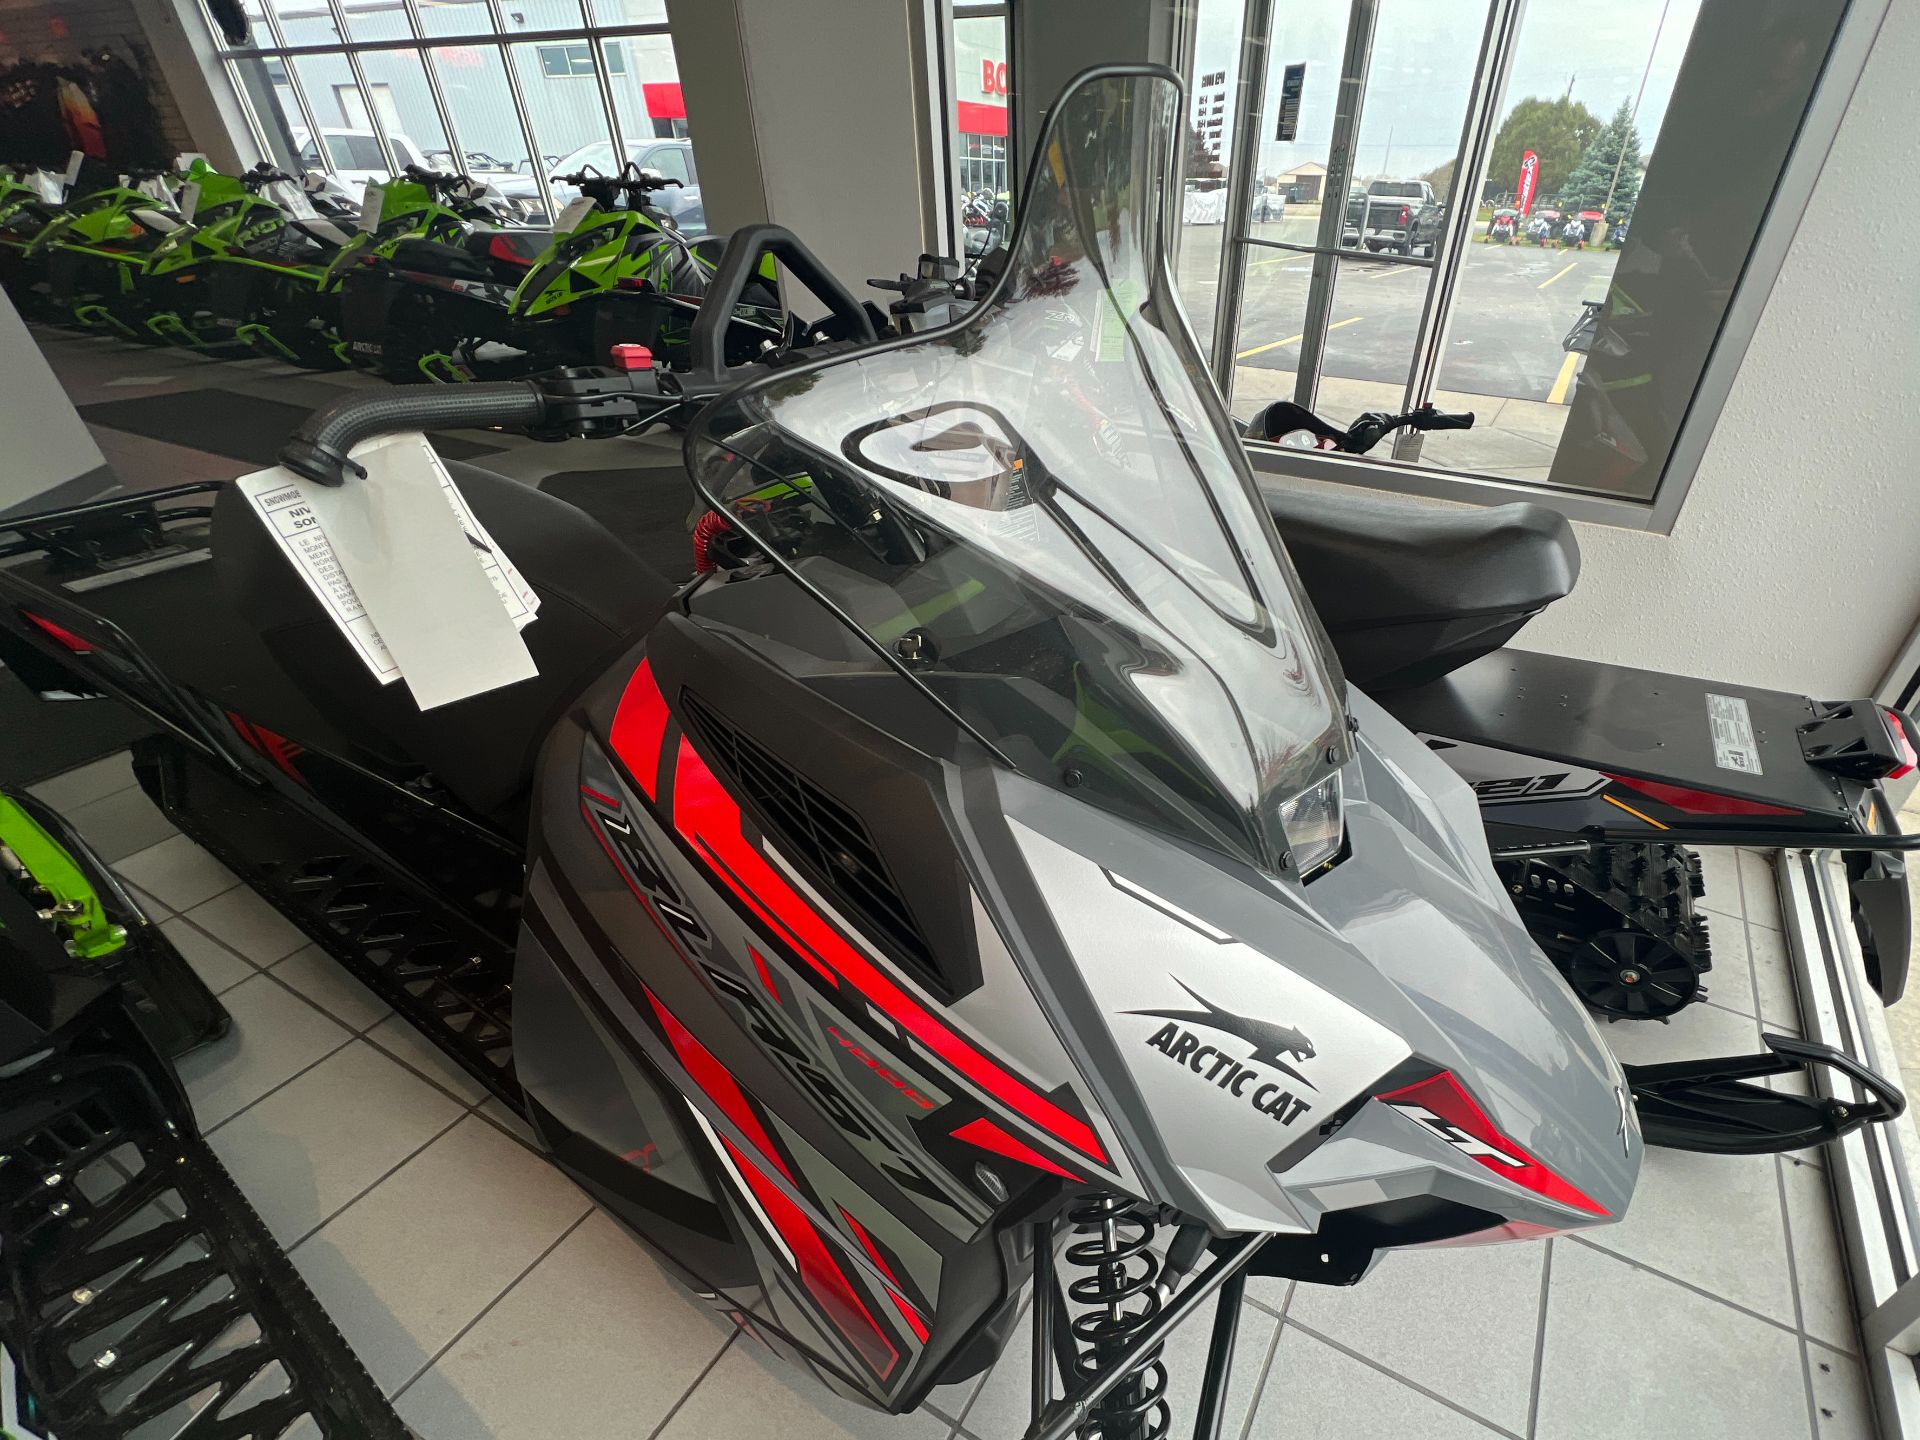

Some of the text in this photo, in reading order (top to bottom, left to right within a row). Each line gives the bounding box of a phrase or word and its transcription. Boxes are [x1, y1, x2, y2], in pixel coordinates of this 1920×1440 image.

[1145, 1021, 1312, 1128] ARCTIC CAT
[1391, 1103, 1531, 1168] LT
